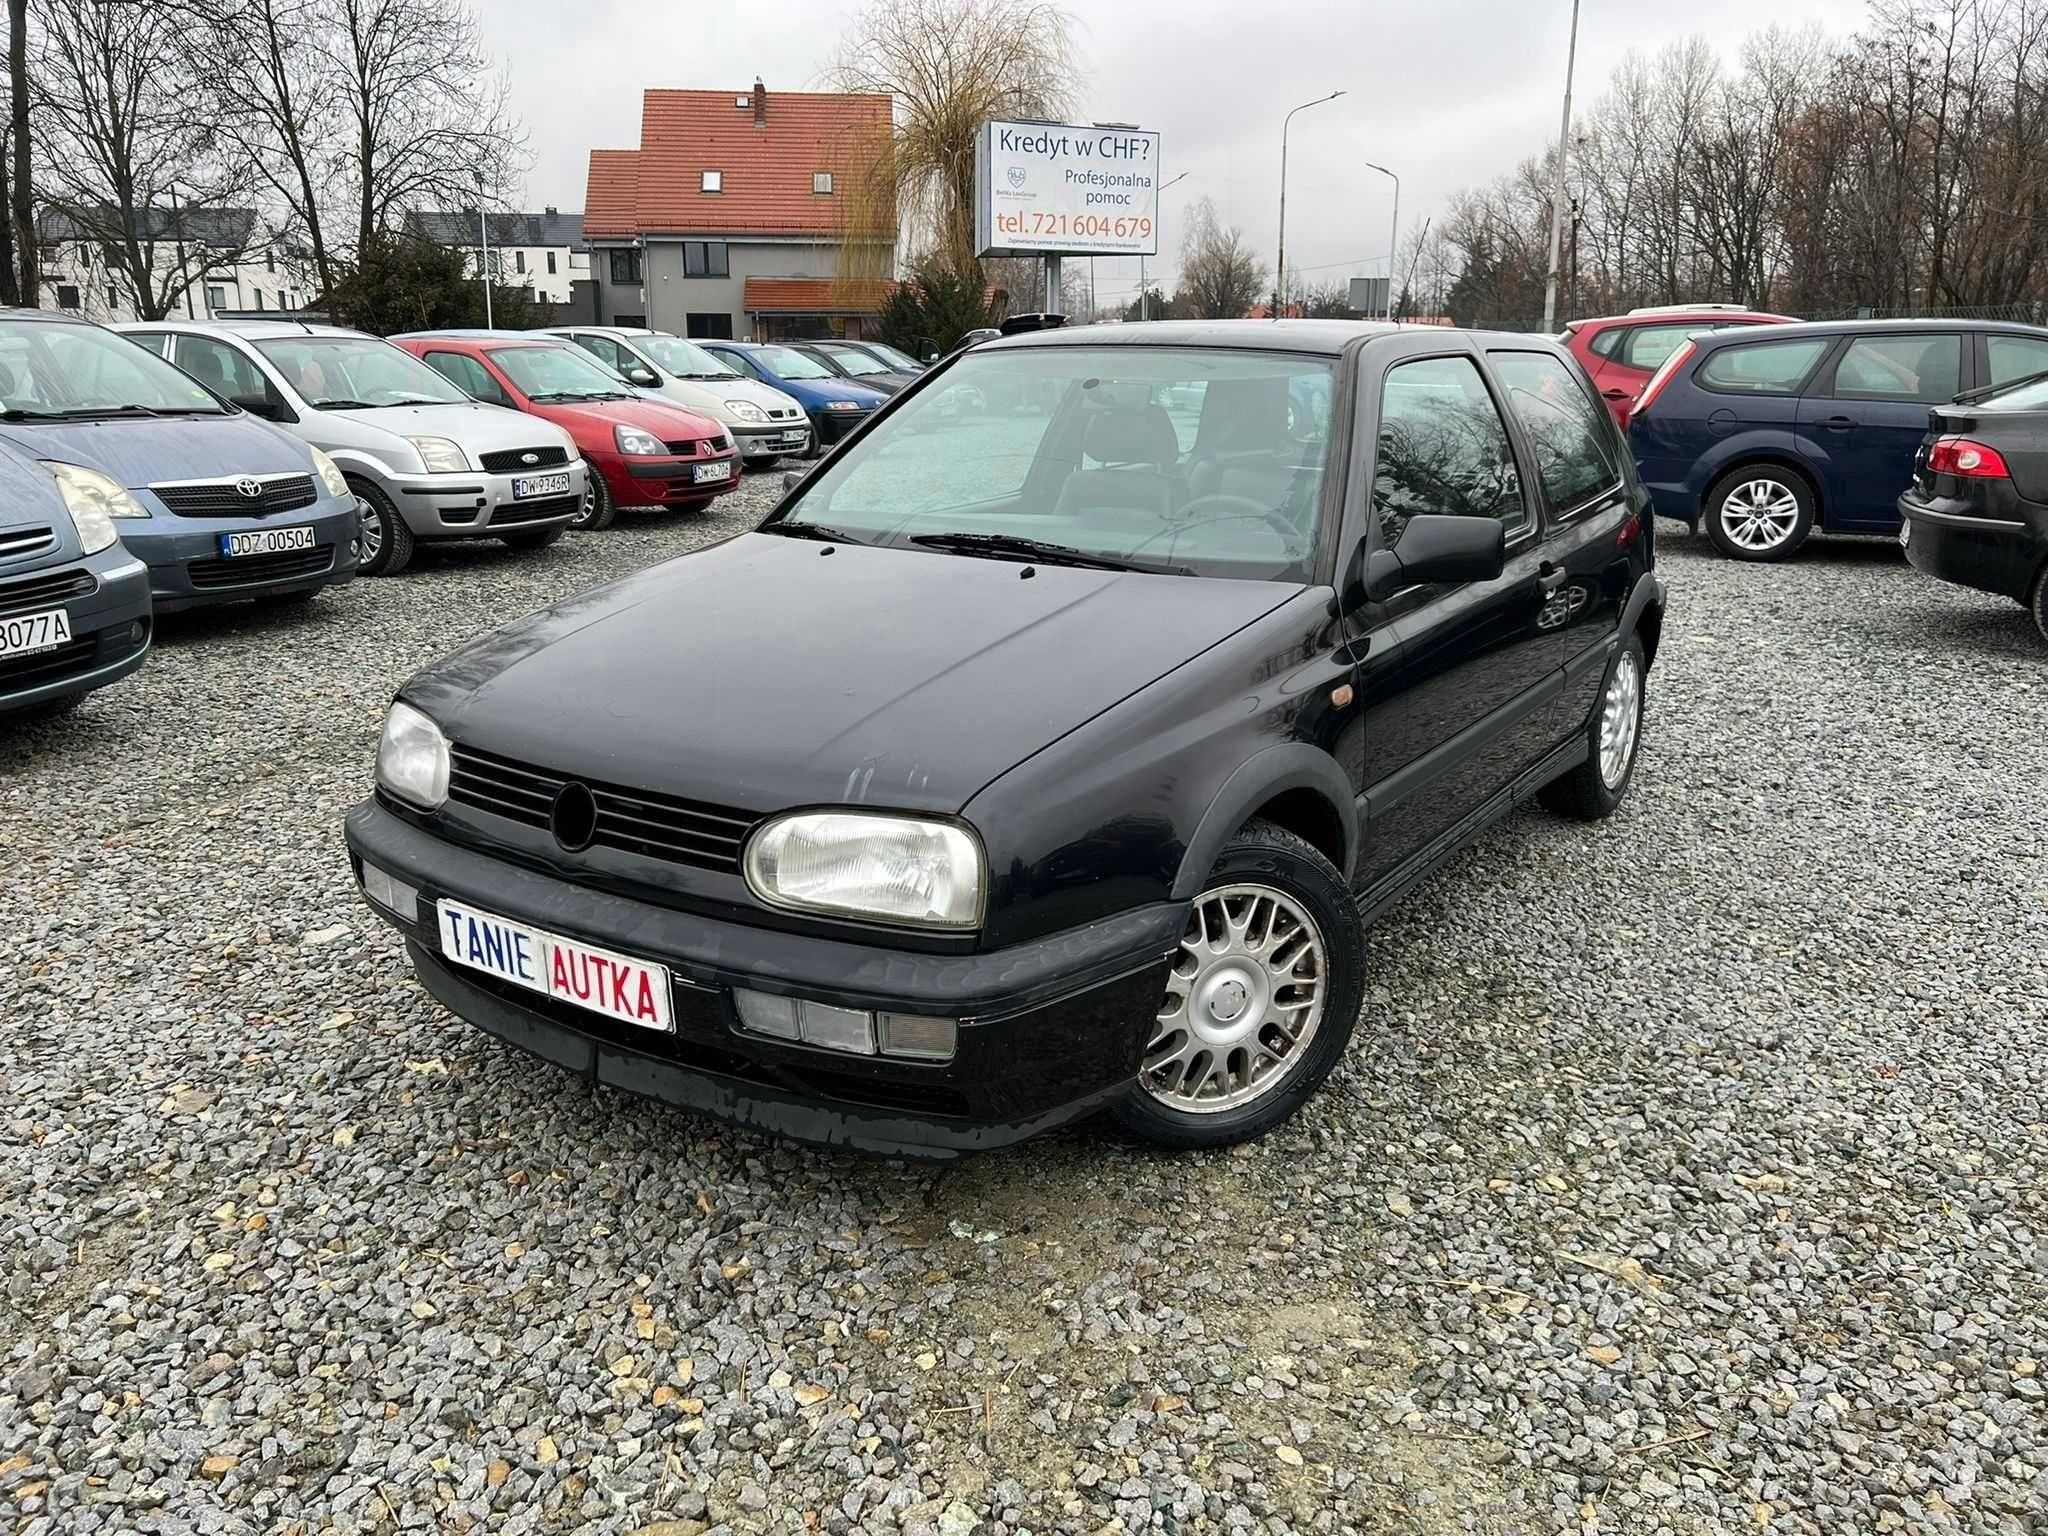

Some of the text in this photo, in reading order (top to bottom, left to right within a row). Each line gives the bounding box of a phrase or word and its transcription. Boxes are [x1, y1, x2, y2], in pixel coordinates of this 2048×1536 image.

[1000, 129, 1150, 160] Kredyt w CHF?
[1065, 169, 1151, 188] Profesjonalna
[1086, 192, 1131, 205] pomoc
[1073, 215, 1111, 236] 604
[1114, 217, 1151, 239] 679
[267, 529, 314, 551] 00504
[445, 909, 657, 1022] TANIE AUTKA
